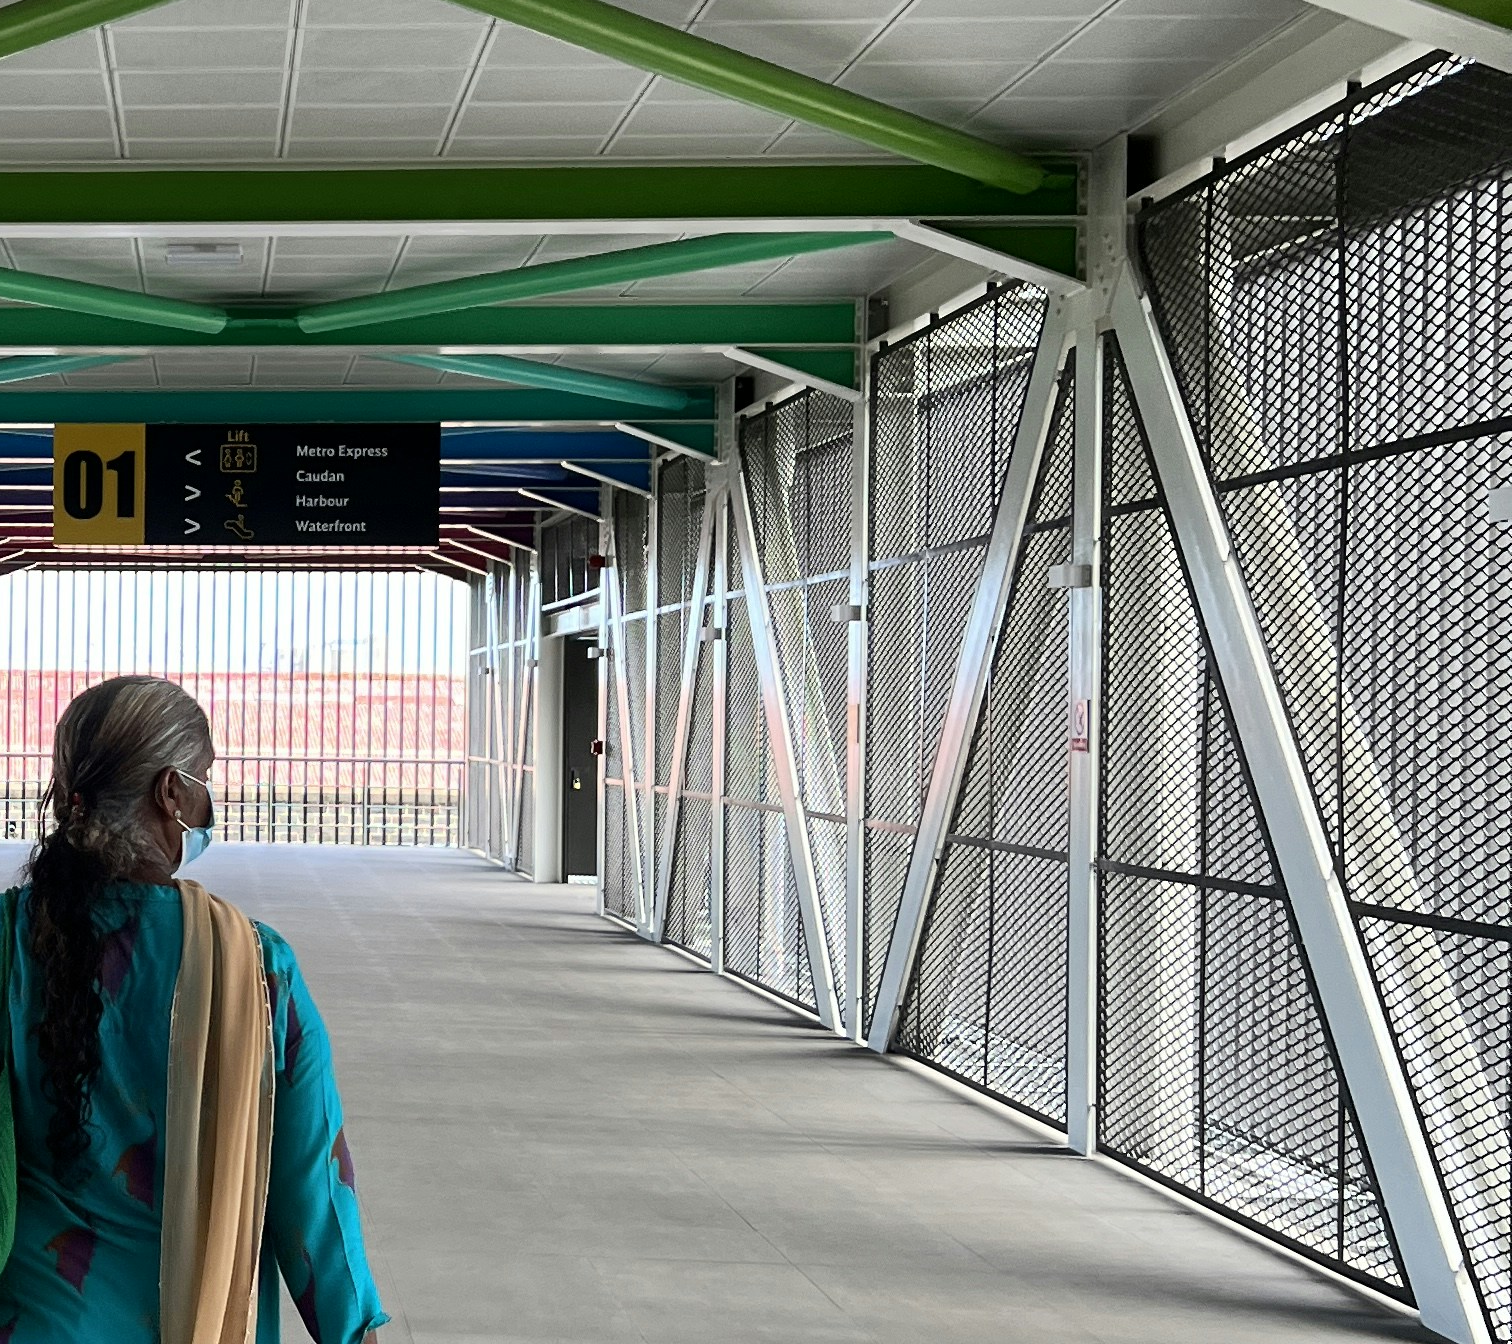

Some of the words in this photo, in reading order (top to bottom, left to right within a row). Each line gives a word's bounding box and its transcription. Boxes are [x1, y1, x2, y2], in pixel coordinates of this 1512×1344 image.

[227, 429, 250, 442] Lift
[296, 445, 335, 457] Metro
[338, 444, 388, 459] Express
[296, 469, 345, 482] Caudan
[63, 450, 136, 520] 01
[295, 494, 350, 507] Harbour
[295, 519, 367, 532] Waterfront
